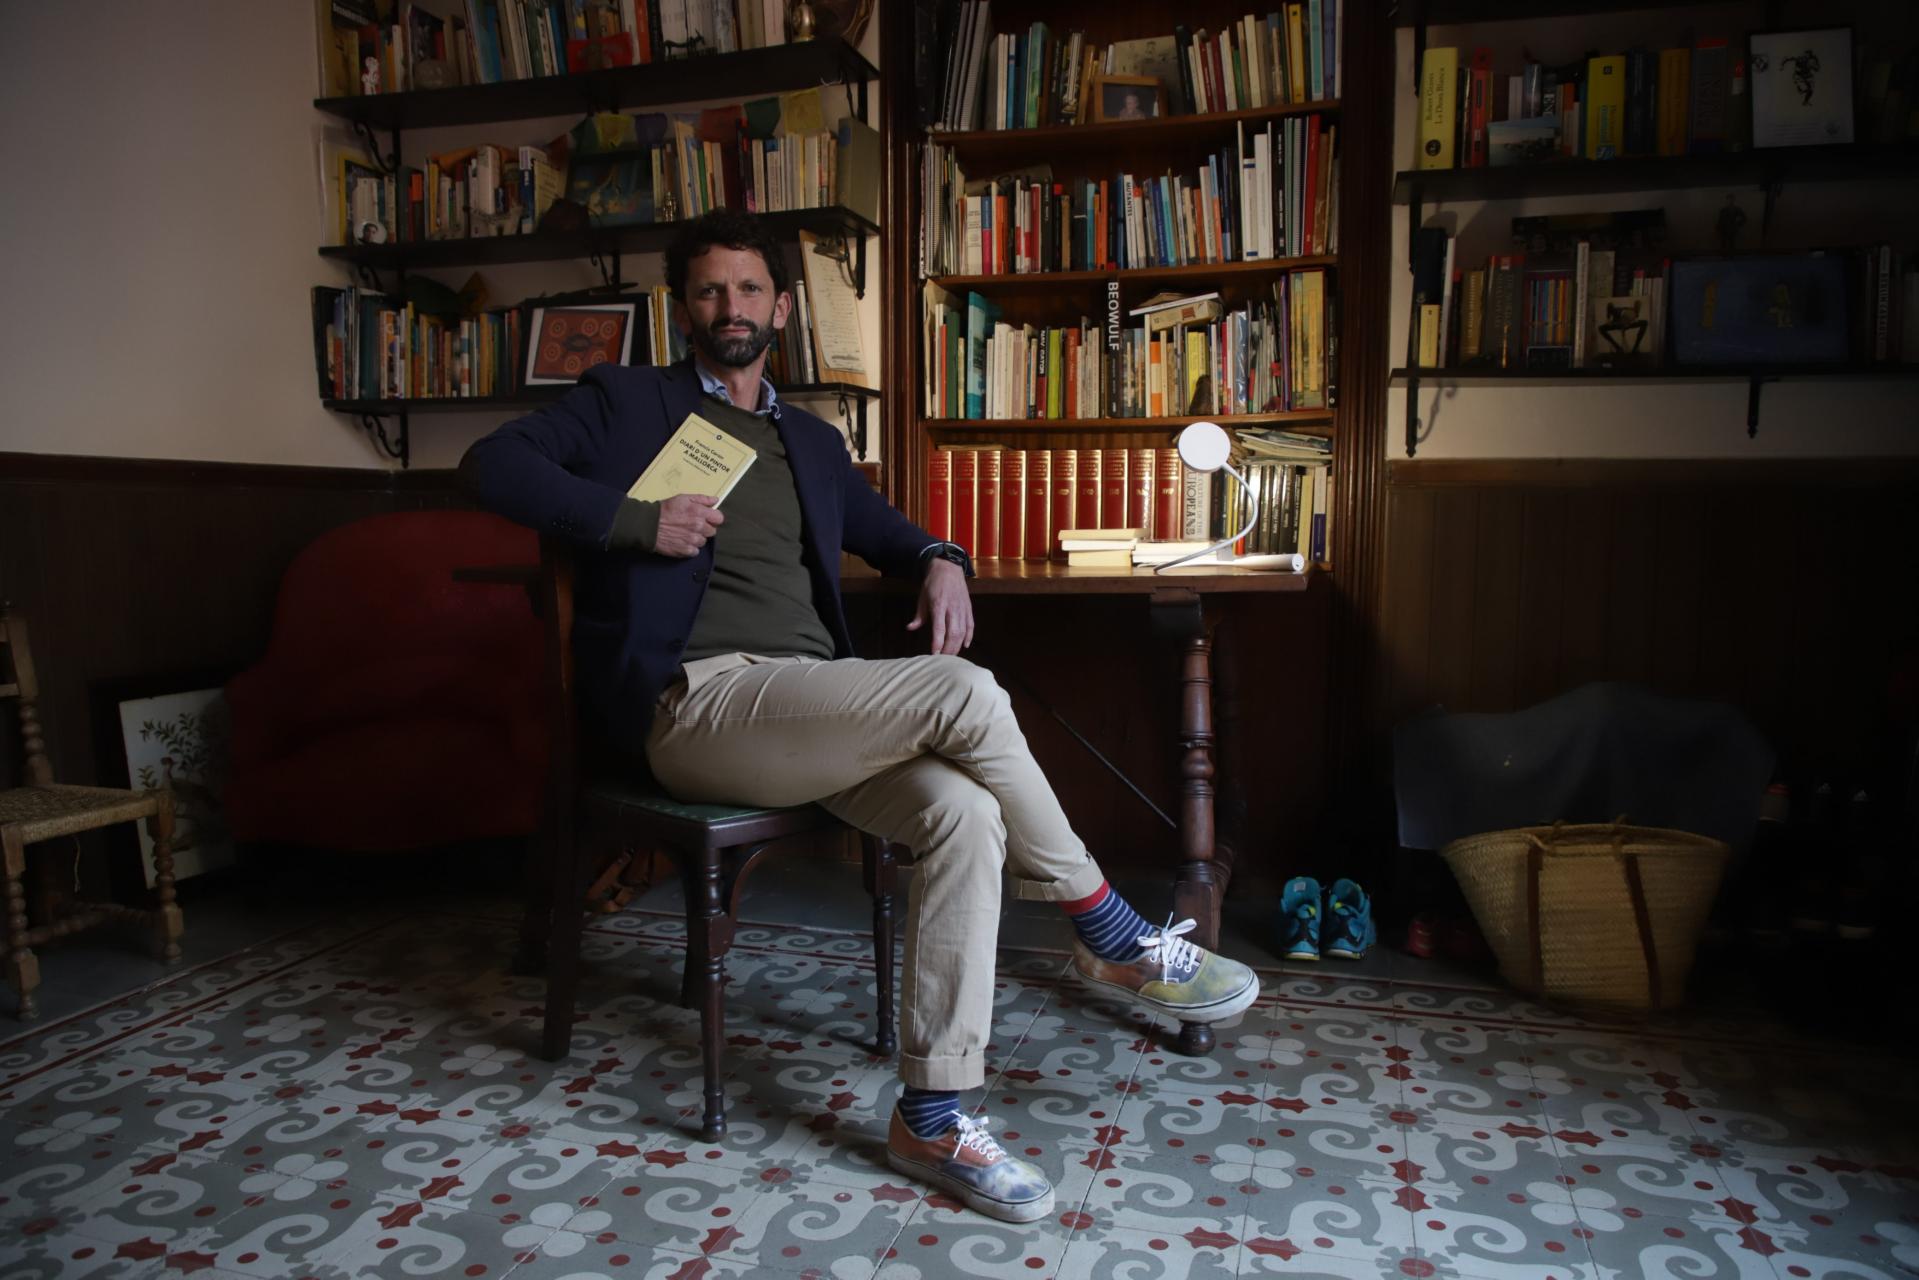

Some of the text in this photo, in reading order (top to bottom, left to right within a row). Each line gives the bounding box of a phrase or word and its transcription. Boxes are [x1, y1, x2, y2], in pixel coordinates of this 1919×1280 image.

[1436, 67, 1445, 92] Blanca
[1125, 182, 1133, 217] MUTANTES
[1108, 281, 1120, 351] BEOWULF
[679, 439, 695, 451] DIARI
[710, 458, 730, 473] PINTOR
[689, 453, 717, 473] MALLORCA
[1186, 471, 1197, 535] UROPEANS
